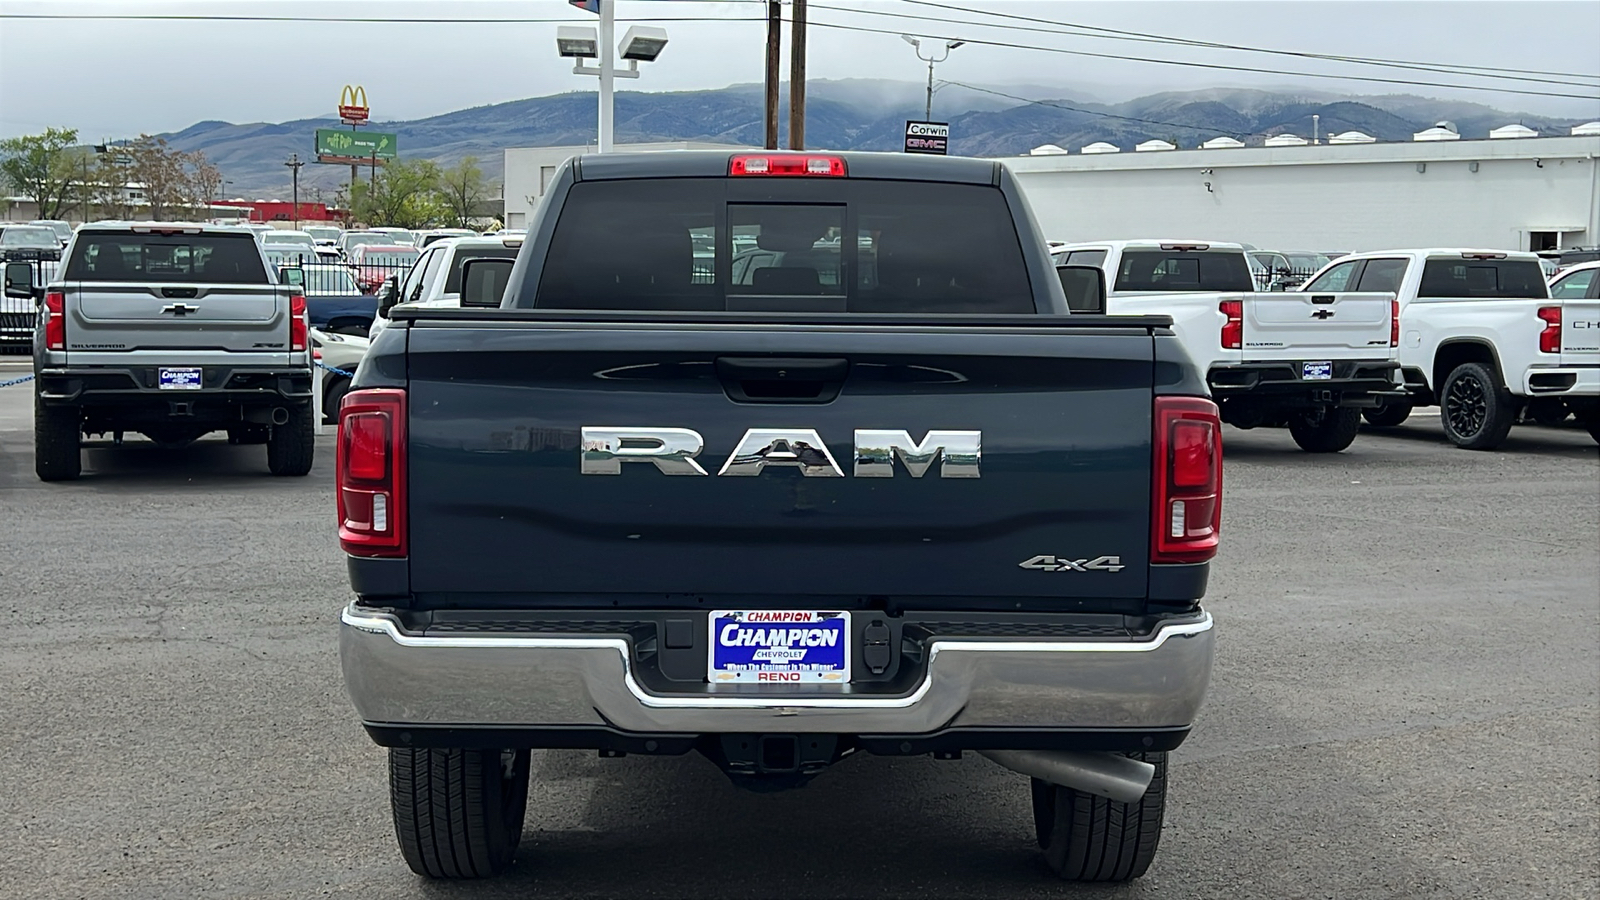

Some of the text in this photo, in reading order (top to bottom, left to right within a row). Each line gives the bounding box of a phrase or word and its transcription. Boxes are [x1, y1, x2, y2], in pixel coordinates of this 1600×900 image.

[911, 125, 947, 135] Corwin
[907, 139, 945, 149] GMC
[161, 371, 199, 379] CHAMPION
[580, 426, 983, 478] RAM
[1018, 555, 1126, 572] 4x4
[747, 612, 812, 622] CHAMPION
[720, 623, 839, 647] CHAMPION
[758, 672, 801, 681] RENO
